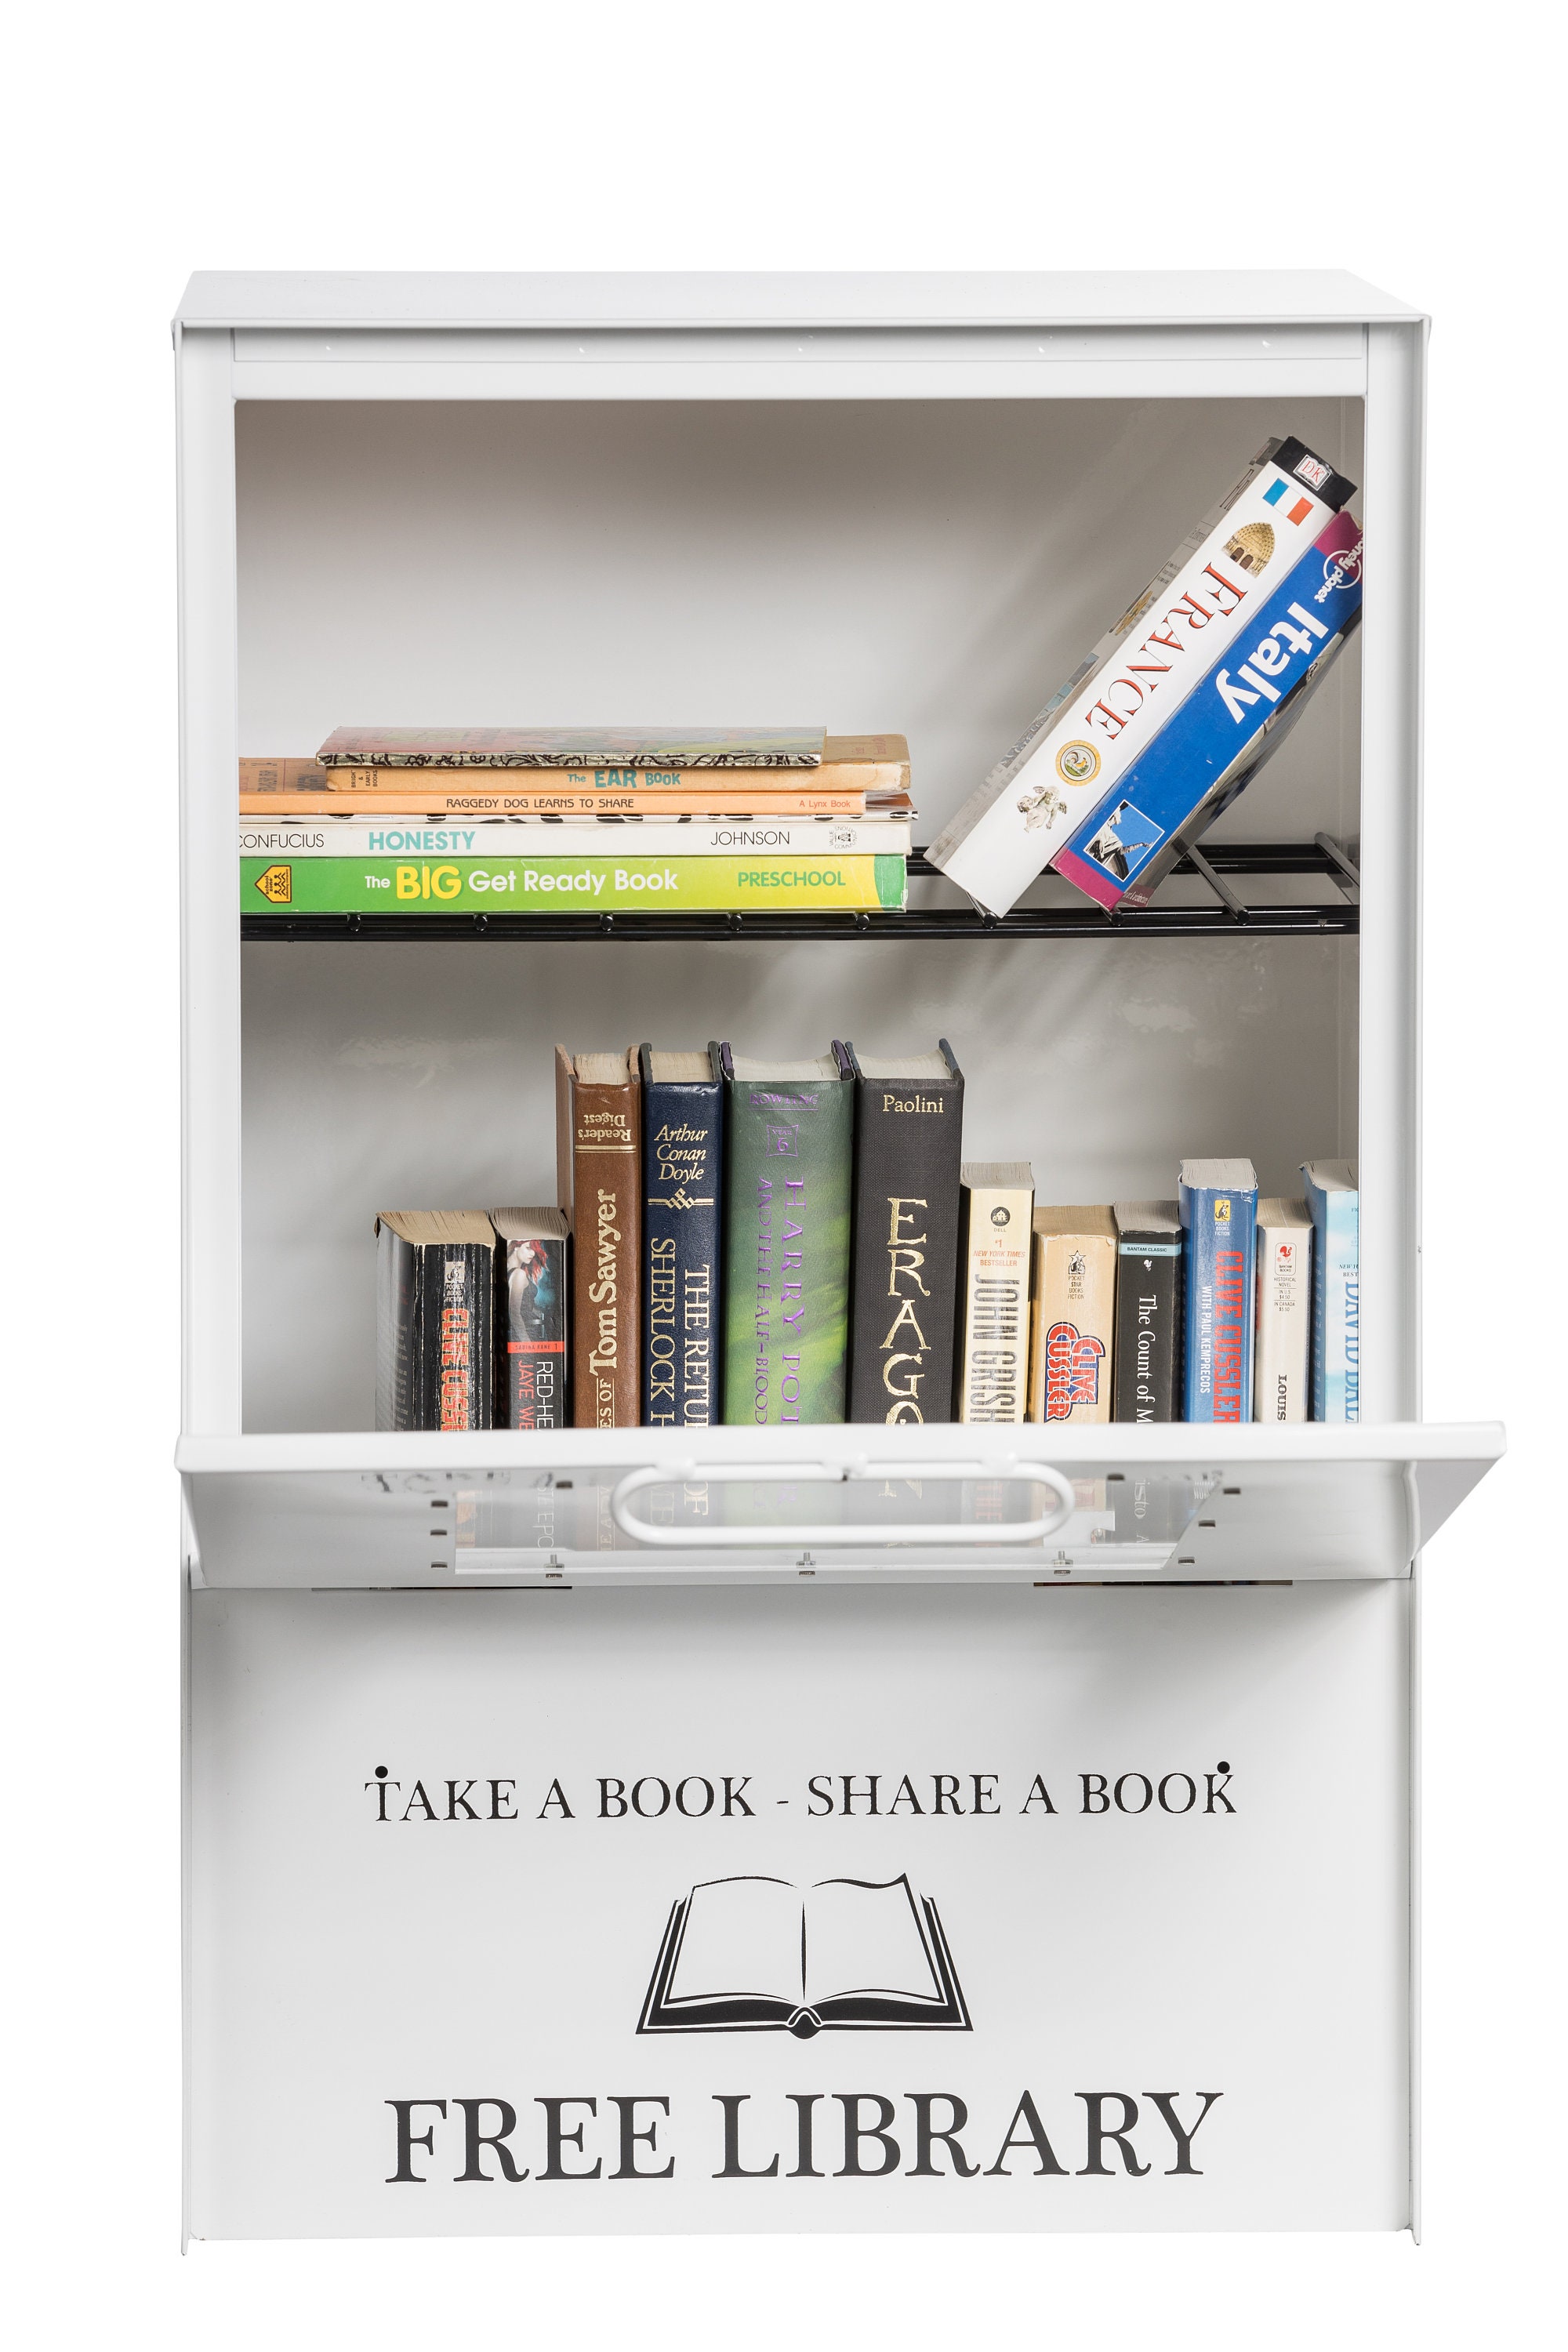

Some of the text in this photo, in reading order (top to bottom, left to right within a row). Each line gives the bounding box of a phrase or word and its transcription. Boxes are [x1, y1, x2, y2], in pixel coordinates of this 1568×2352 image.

[1301, 460, 1325, 484] DK
[1314, 536, 1363, 604] onely planet
[1085, 562, 1248, 741] FRANCE
[1215, 601, 1330, 724] Italy
[567, 769, 681, 788] The EAR BOOK
[446, 799, 634, 808] RAGGEDY DOG LEARNS TO SHARE
[809, 800, 827, 809] Lynx
[368, 831, 476, 851] HONESTY
[710, 831, 790, 846] JOHNSON
[365, 866, 679, 899] The BIG Get Ready Book
[738, 871, 846, 887] PRESCHOOL
[583, 1112, 626, 1127] Digest
[883, 1094, 944, 1113] Paolini
[578, 1129, 632, 1142] Reader's
[654, 1123, 708, 1142] Arthur
[656, 1144, 706, 1161] Conan
[777, 1138, 789, 1152] 6
[659, 1163, 705, 1185] Doyle
[757, 1176, 772, 1226] AND
[588, 1189, 622, 1305] Sawyer
[757, 1229, 773, 1276] THE
[780, 1176, 807, 1336] HARRY
[650, 1237, 676, 1401] SHERLOCK
[684, 1265, 710, 1330] THE
[1138, 1294, 1157, 1324] The
[441, 1308, 470, 1366] CLIVE
[589, 1308, 617, 1376] Tom
[970, 1273, 1020, 1423] JOHN GRISH
[1137, 1330, 1156, 1379] Count
[1200, 1286, 1212, 1393] WITH PAUL KEMPRECOS
[1213, 1250, 1244, 1423] CLIVE CUSSLER
[518, 1360, 535, 1399] JAYE
[599, 1377, 612, 1402] OF
[1047, 1324, 1078, 1418] CUSSLER
[1071, 1338, 1103, 1403] CLIVE
[1137, 1385, 1156, 1403] of
[536, 1362, 554, 1431] RED-HE
[1276, 1374, 1287, 1421] LOUIS
[365, 1777, 517, 1821] TAKE
[537, 1779, 575, 1818] A
[597, 1777, 756, 1817] BOOK
[808, 1775, 1000, 1816] SHARE
[1019, 1774, 1058, 1813] A
[1078, 1773, 1236, 1813] BOOK
[385, 2090, 1223, 2183] FREE LIBRARY
